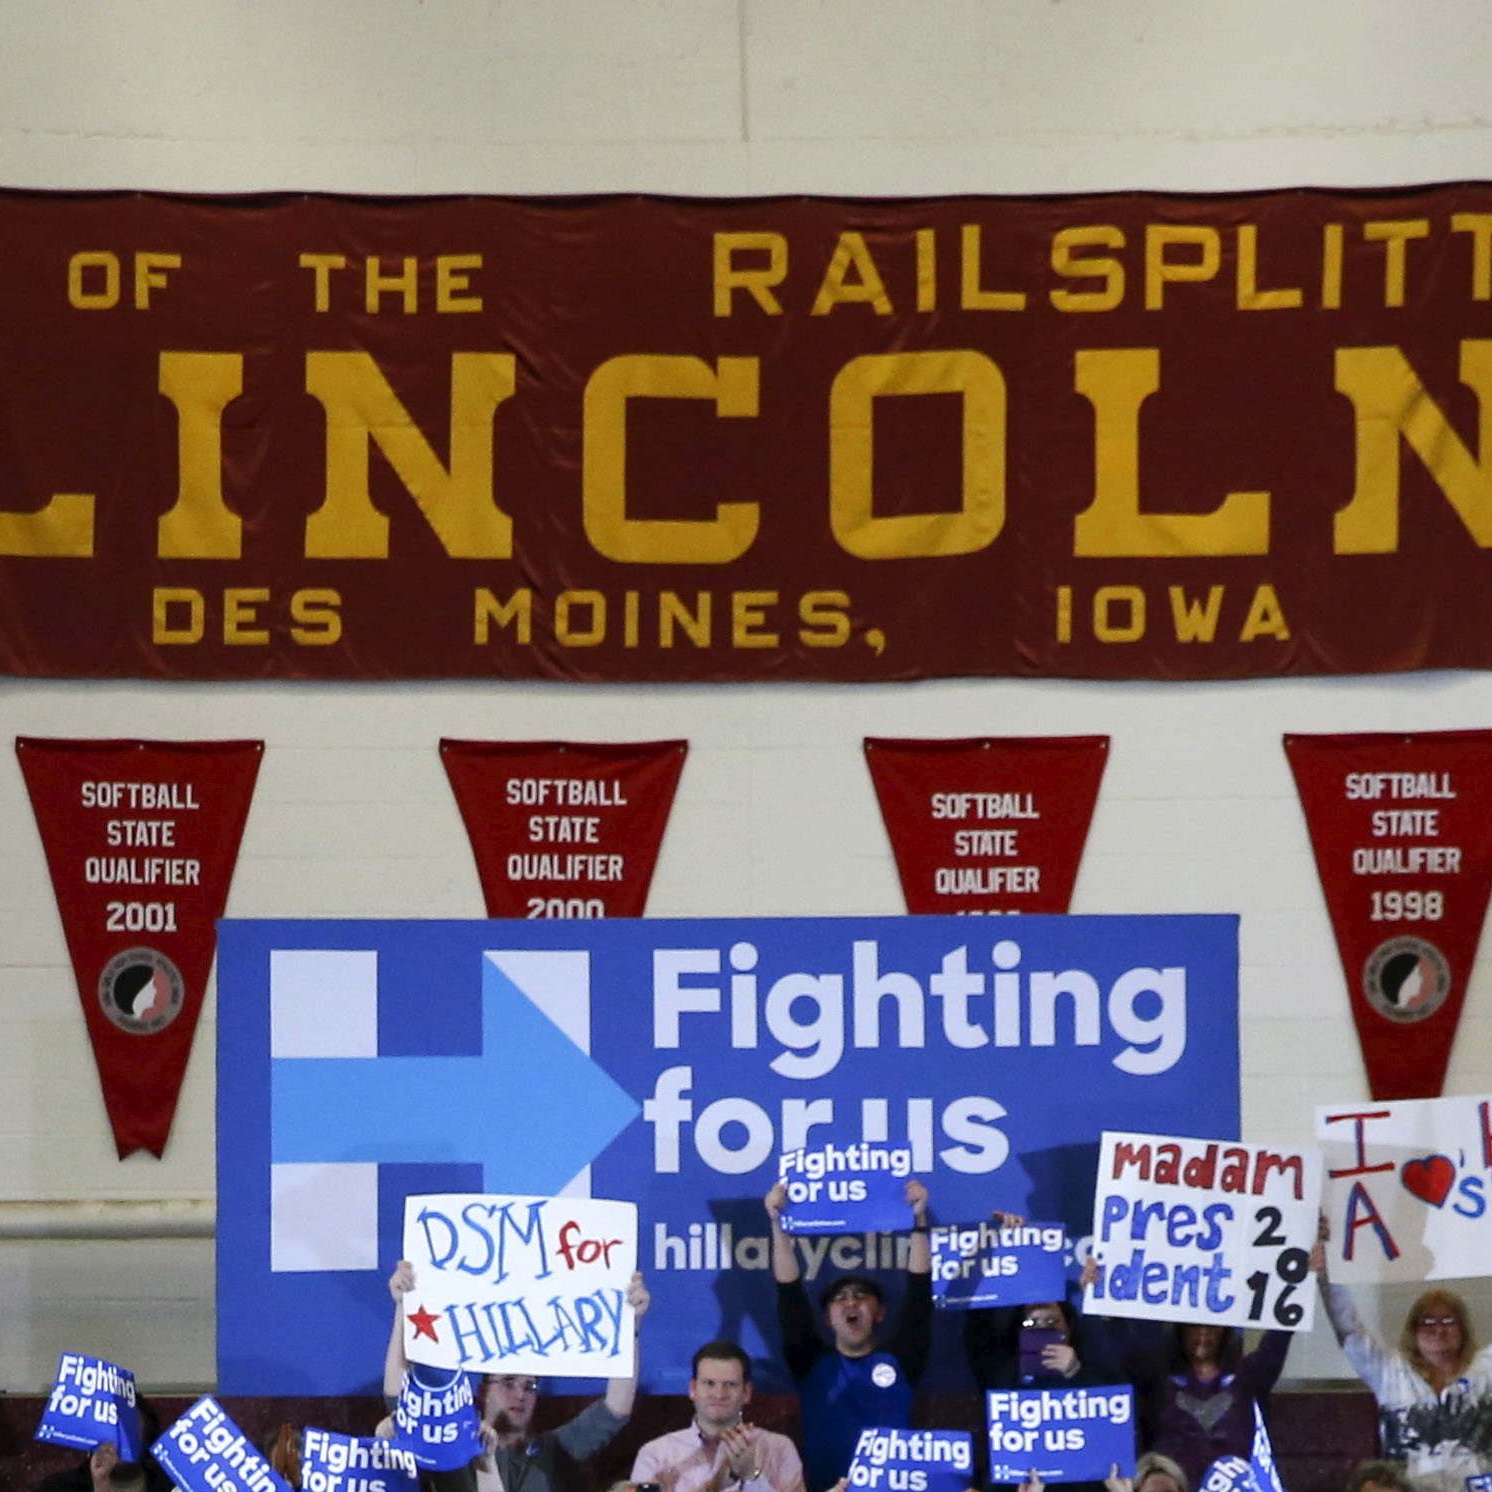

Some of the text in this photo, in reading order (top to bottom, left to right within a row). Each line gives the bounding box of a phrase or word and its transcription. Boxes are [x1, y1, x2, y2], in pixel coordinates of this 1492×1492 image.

[69, 252, 181, 309] OF
[300, 253, 482, 313] THE
[153, 585, 1289, 655] DES MOINES, IOWA
[82, 782, 199, 809] SOFTBALL
[507, 779, 627, 805] SOFTBALL
[1346, 773, 1456, 799] SOFTBALL
[932, 793, 1039, 818] SOFTBALL
[108, 820, 175, 846] STATE
[529, 816, 600, 843] STATE
[1373, 810, 1438, 836] STATE
[955, 830, 1017, 856] STATE
[86, 858, 200, 885] QUALIFIER
[508, 854, 623, 880] QUALIFIER
[1353, 847, 1461, 874] QUALIFIER
[935, 867, 1039, 894] QUALIFIER
[107, 902, 176, 931] 2001
[1371, 891, 1443, 920] 1998
[653, 941, 1186, 1083] Fighting
[643, 1066, 1009, 1175] for us
[417, 1200, 623, 1285] DSM for
[1093, 1249, 1235, 1314] ident
[444, 1289, 623, 1363] HILLARY
[990, 1390, 1130, 1435] Fighting
[989, 1423, 1084, 1451] for us
